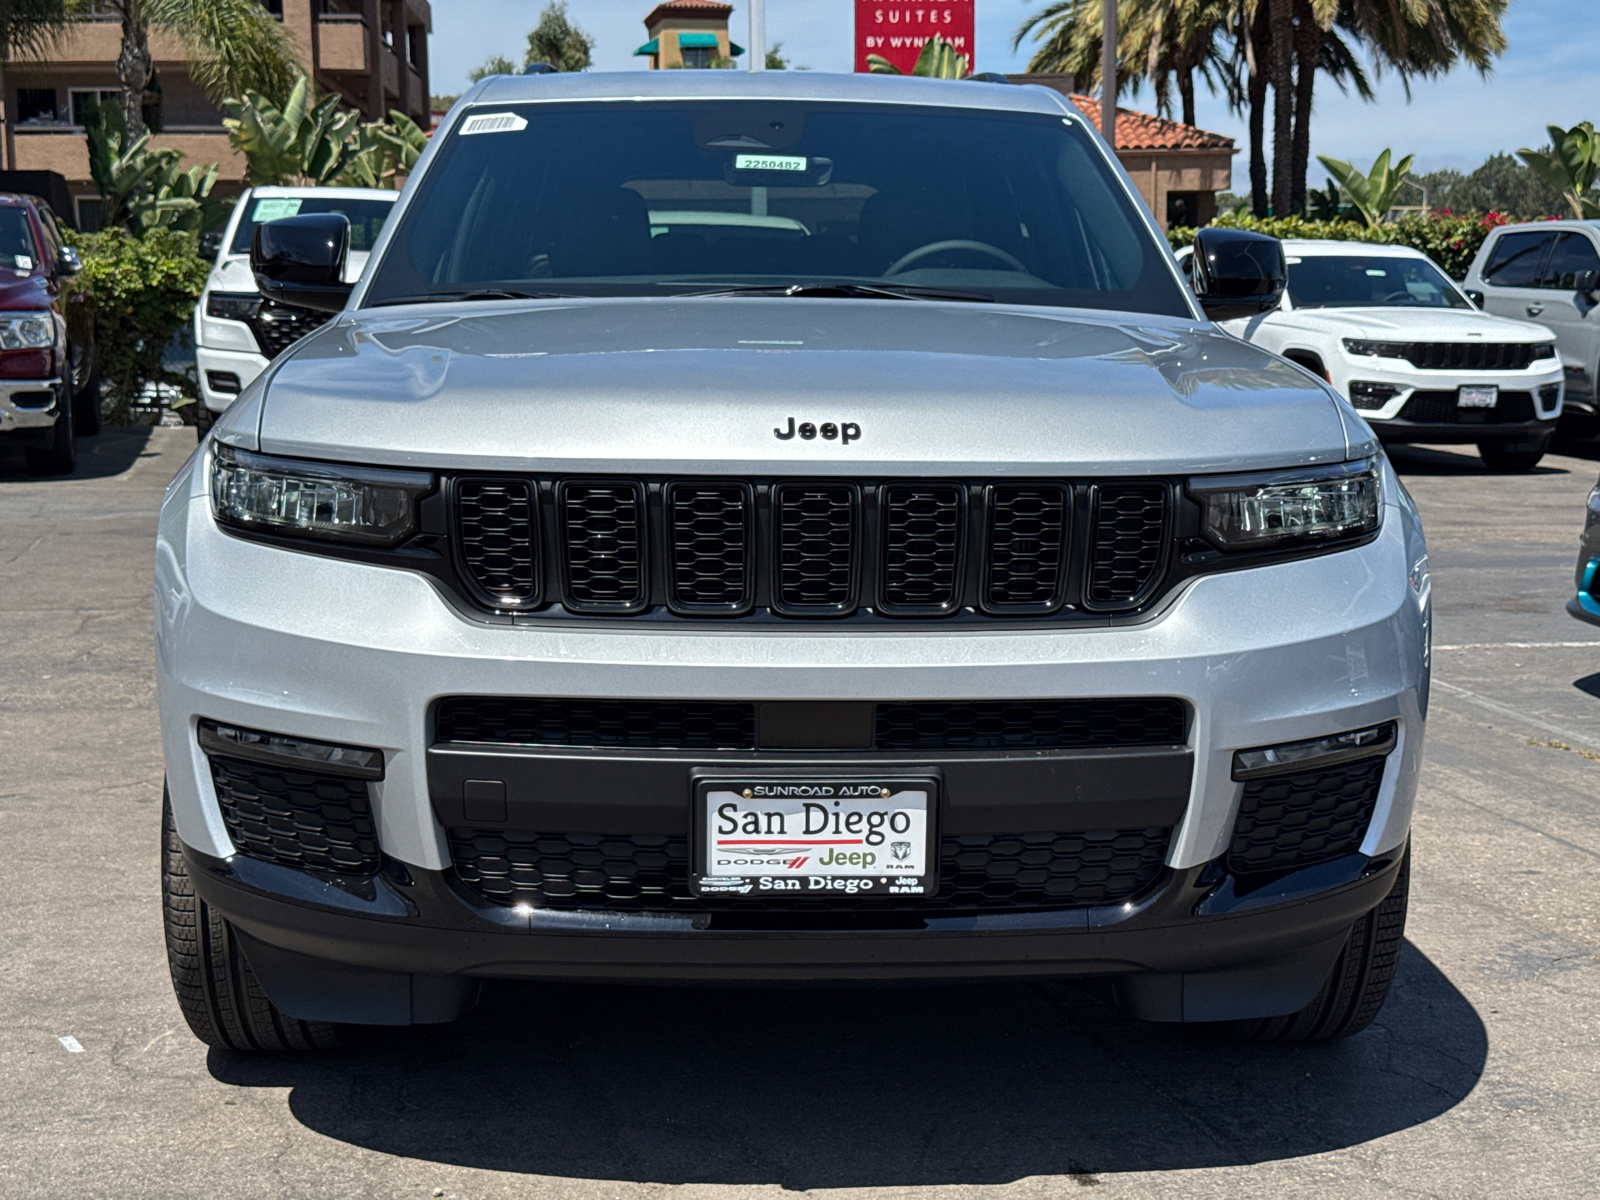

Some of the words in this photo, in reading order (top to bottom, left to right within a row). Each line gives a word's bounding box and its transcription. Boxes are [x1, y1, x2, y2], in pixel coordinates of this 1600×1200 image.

[875, 8, 952, 24] SUITES
[865, 35, 885, 48] BY
[744, 160, 801, 170] 2250482
[773, 416, 862, 445] Jeep
[753, 785, 834, 796] SUNROAD
[838, 785, 881, 796] AUTO
[717, 802, 787, 835] San
[802, 800, 911, 846] Diego
[818, 848, 876, 869] Jeep
[759, 876, 801, 890] San
[808, 876, 873, 893] Diego
[895, 876, 919, 887] Jeep
